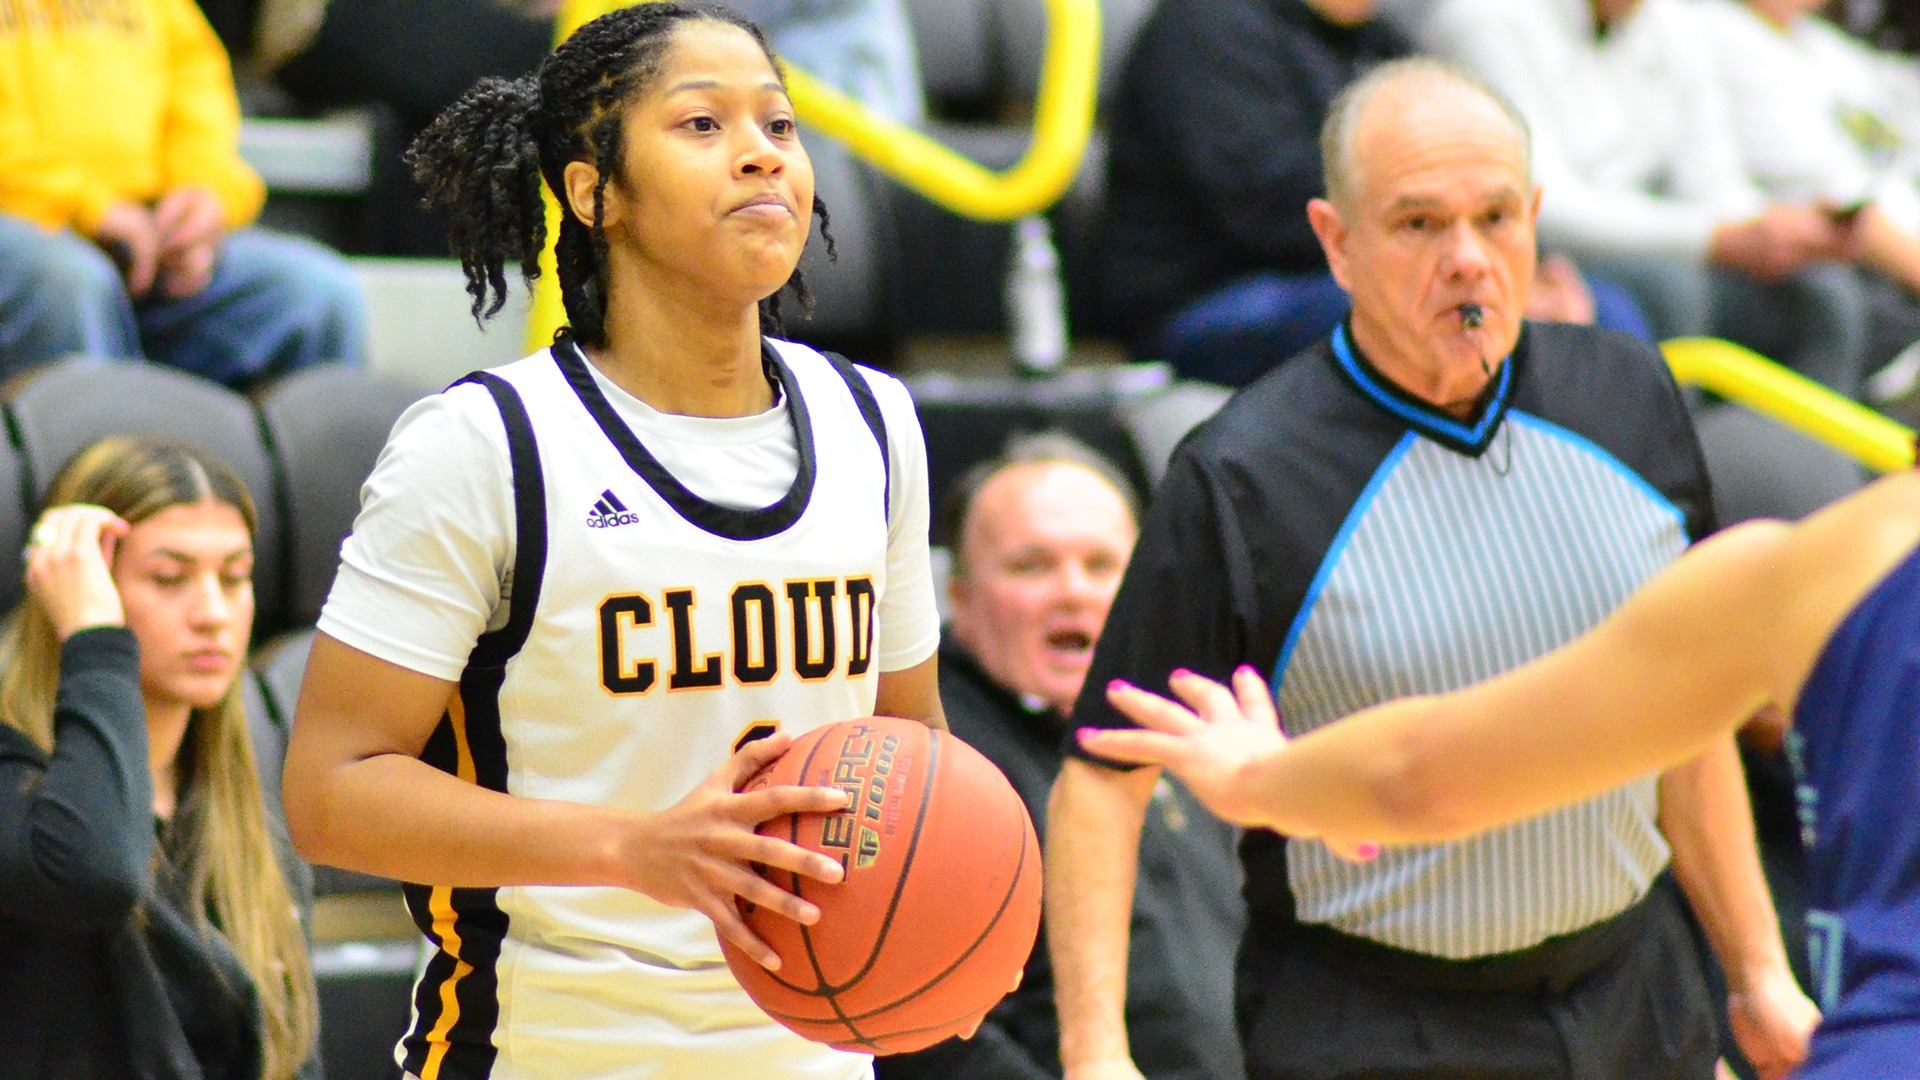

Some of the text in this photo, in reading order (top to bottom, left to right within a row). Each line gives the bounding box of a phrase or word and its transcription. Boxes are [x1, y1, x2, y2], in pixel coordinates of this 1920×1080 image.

[586, 511, 639, 528] adidas
[596, 575, 875, 695] CLOUD
[865, 734, 900, 821] 1000
